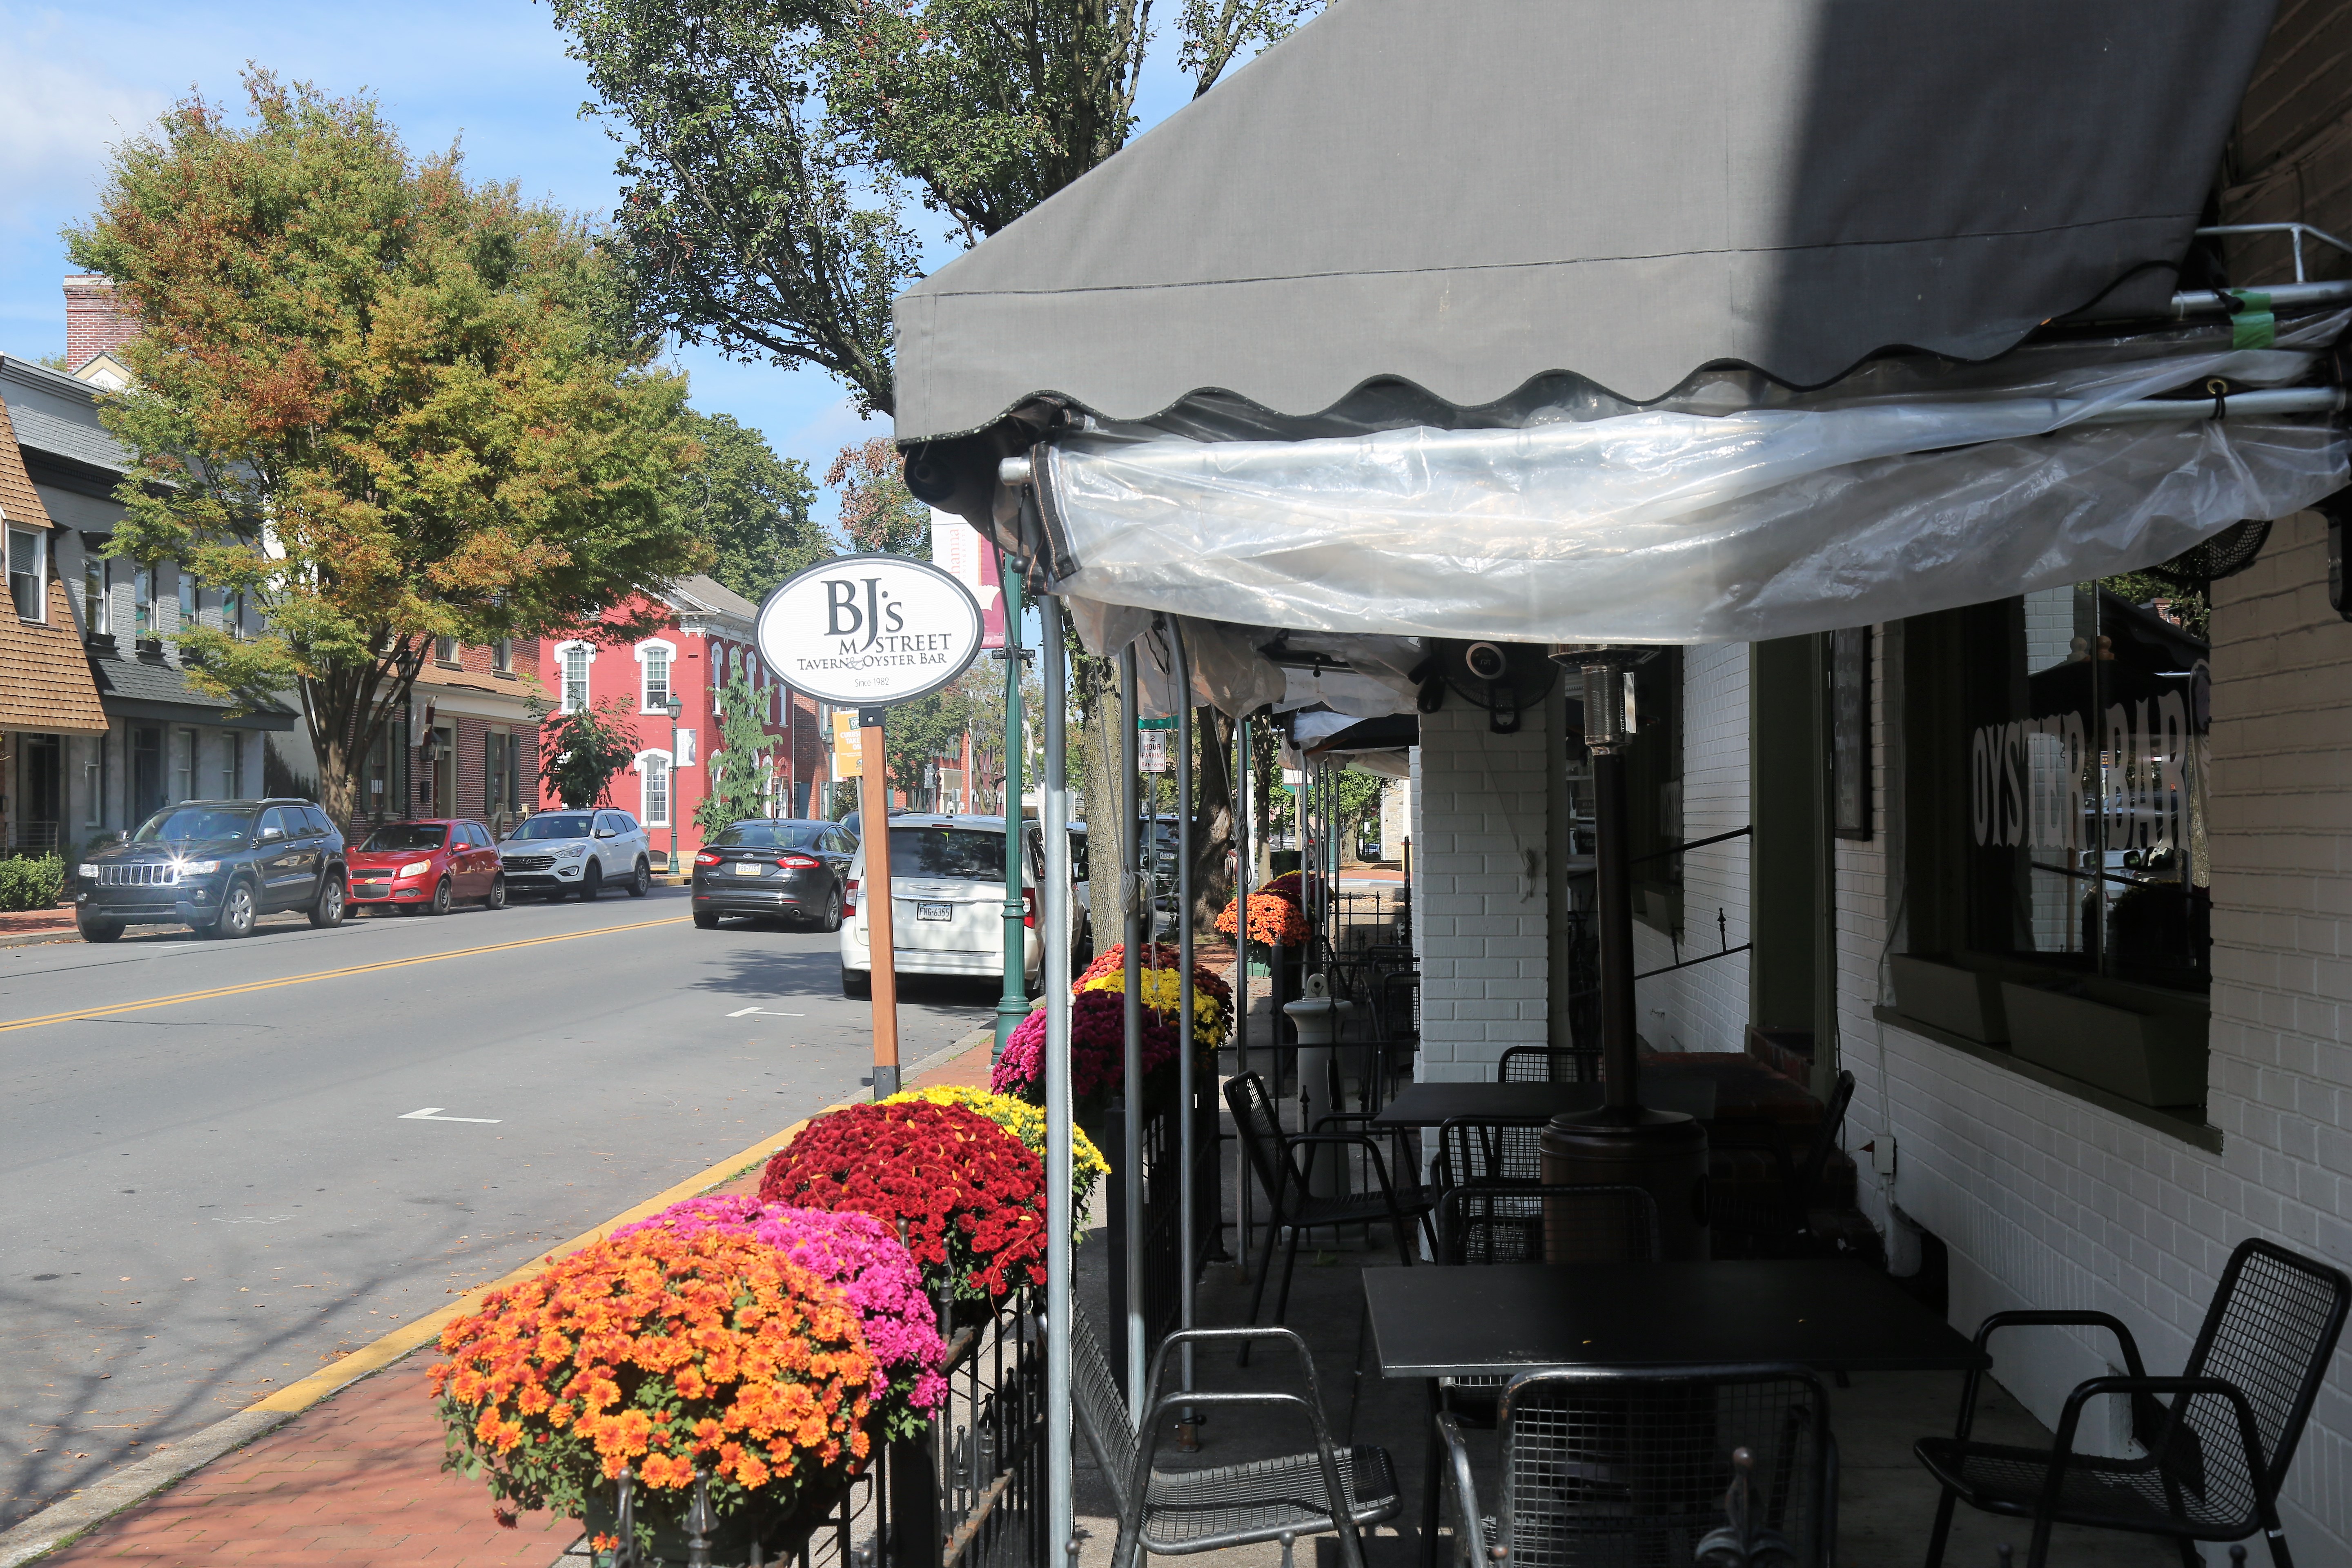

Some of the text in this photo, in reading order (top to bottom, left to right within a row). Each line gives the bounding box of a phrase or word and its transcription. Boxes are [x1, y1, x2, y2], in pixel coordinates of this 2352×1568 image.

[821, 578, 903, 653] BJ's
[839, 633, 952, 655] M STREET
[797, 653, 947, 670] TAVERN & OYSTER BAR
[855, 677, 889, 687] Since 1982
[1973, 690, 2191, 852] OYSTER BAR
